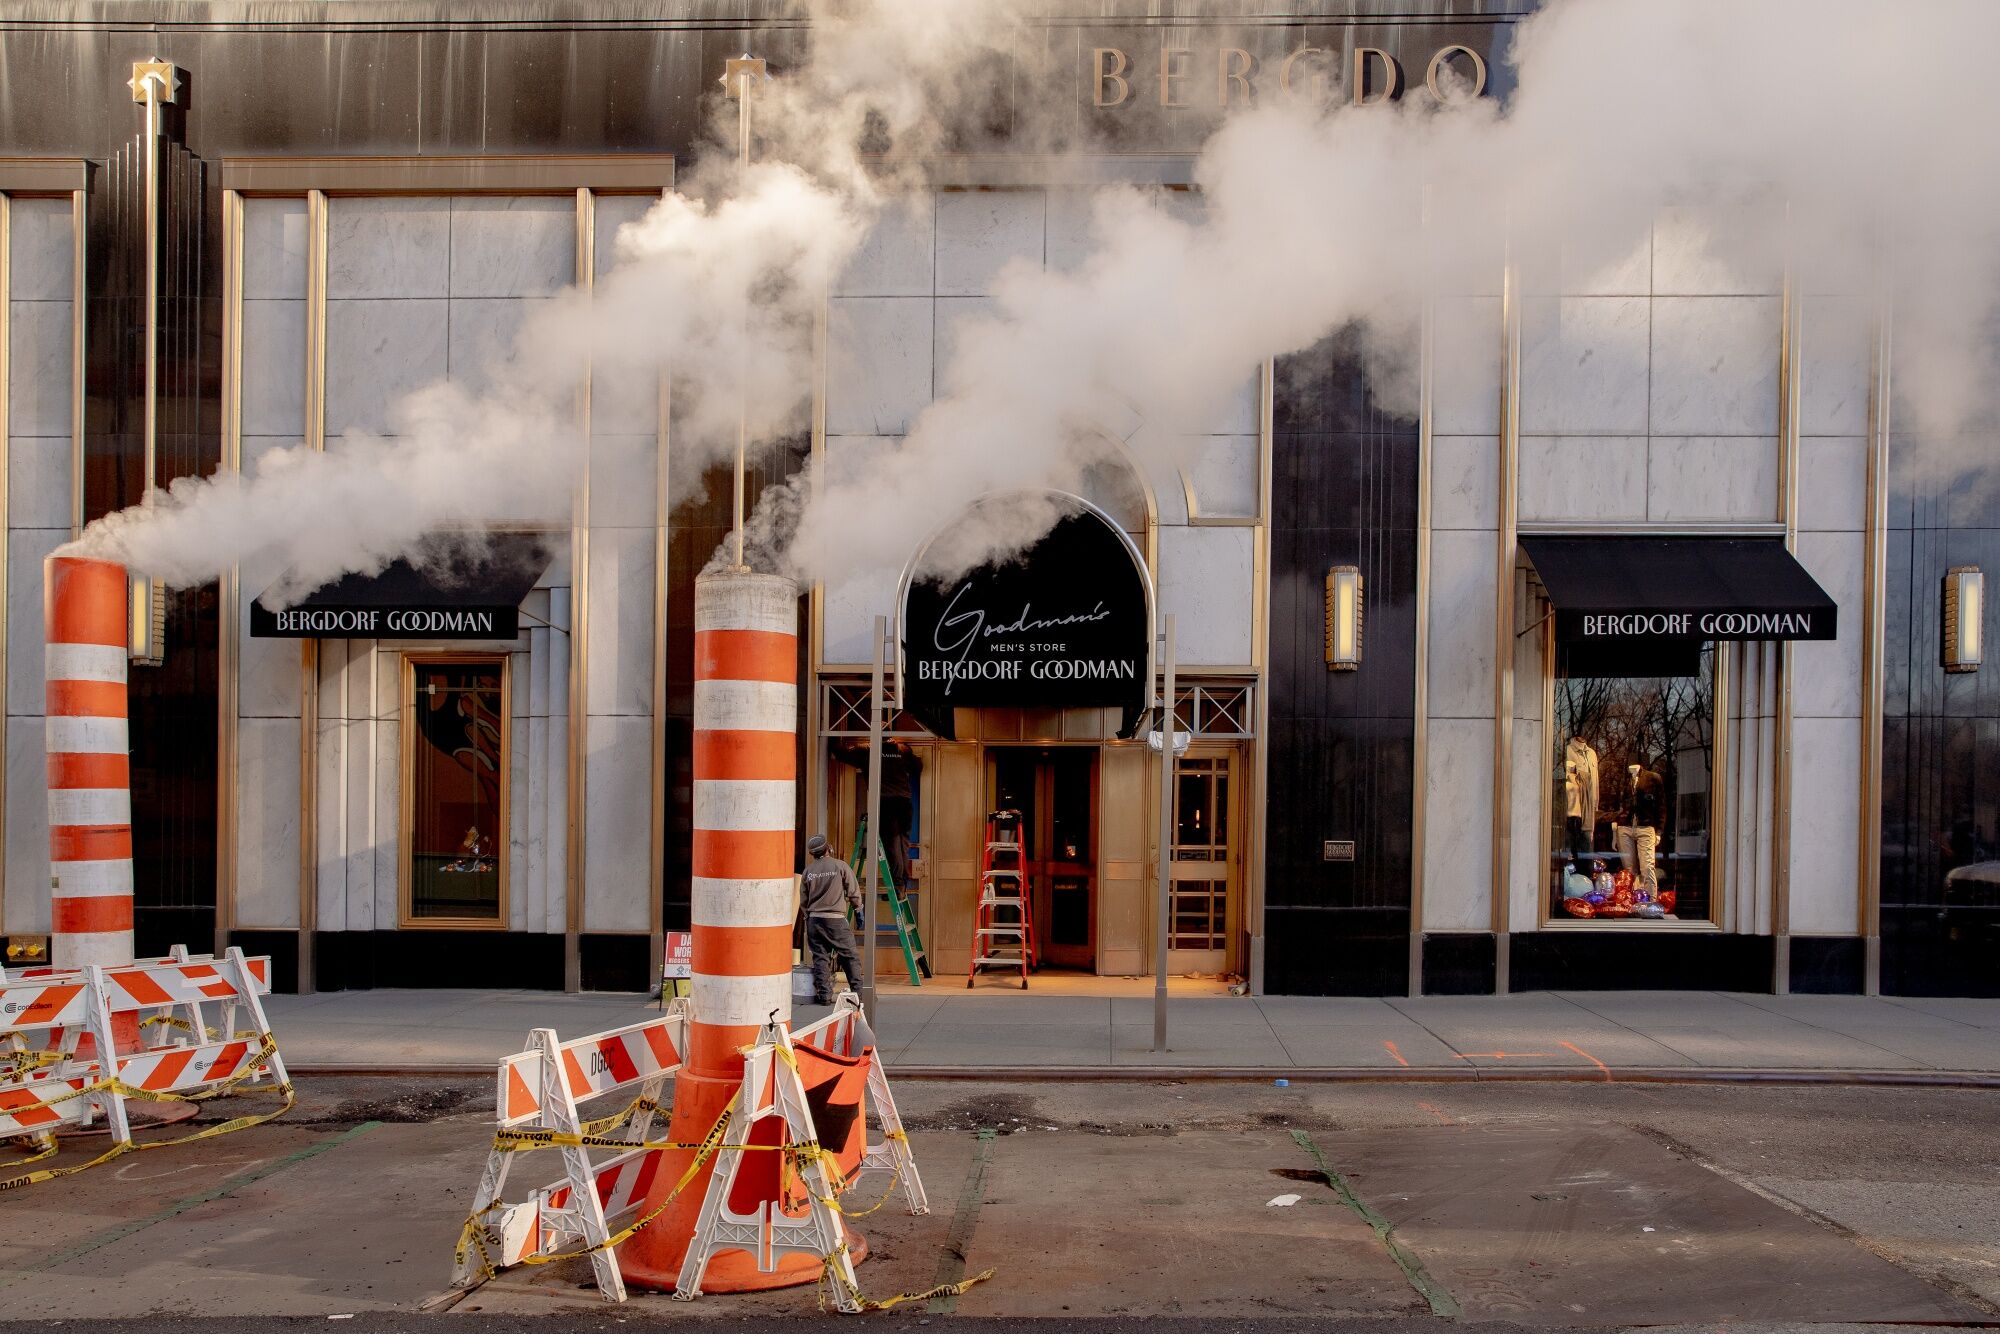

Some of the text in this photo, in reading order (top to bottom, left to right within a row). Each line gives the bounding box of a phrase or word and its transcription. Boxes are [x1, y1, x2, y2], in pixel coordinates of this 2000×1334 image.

[276, 610, 492, 632] BERGDORF GOODMAN
[1583, 613, 1811, 636] BERGDORF GOODMAN
[990, 643, 1066, 652] MEN'S STORE
[919, 659, 1135, 680] BERGDORF GOODMAN
[590, 1047, 615, 1077] DGCC
